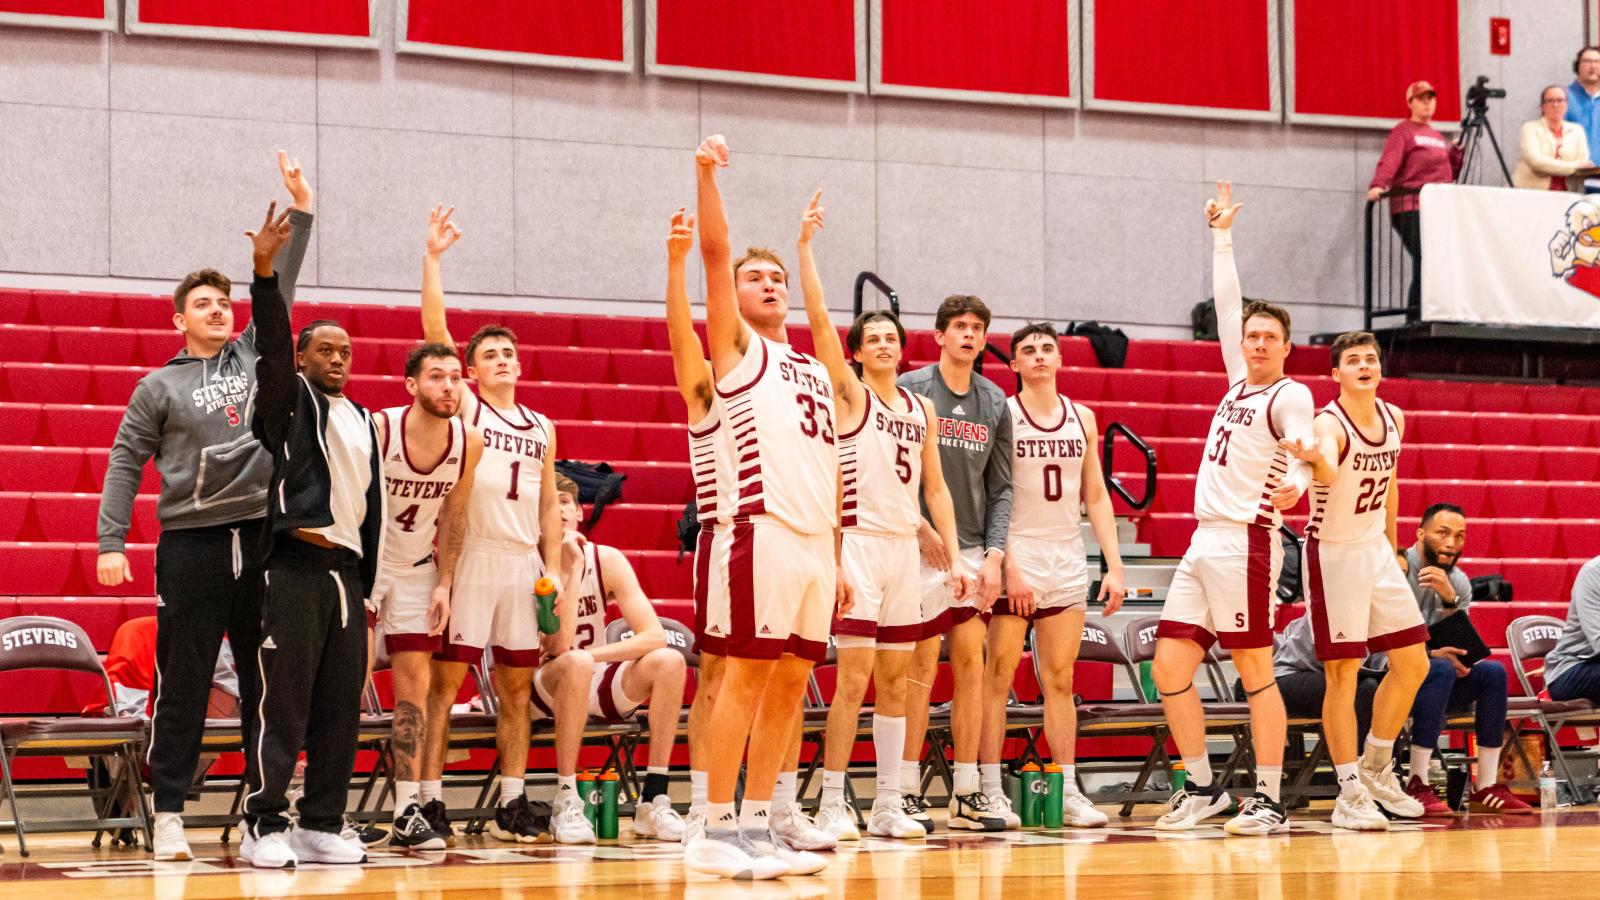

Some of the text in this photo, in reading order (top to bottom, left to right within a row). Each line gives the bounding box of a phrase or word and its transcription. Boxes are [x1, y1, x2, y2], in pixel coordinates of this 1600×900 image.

[192, 371, 248, 407] STEVENS
[779, 362, 833, 400] STVEN
[224, 404, 241, 427] S
[796, 393, 835, 446] 33
[936, 416, 988, 443] TEVENS
[483, 427, 547, 463] STEVENS
[936, 437, 984, 452] SKETBALL
[1016, 439, 1083, 458] STEVENS
[1208, 425, 1232, 467] 31
[895, 443, 912, 485] 5
[385, 476, 453, 499] STEVENS
[506, 460, 520, 502] 1
[1043, 464, 1062, 502] 0
[1354, 476, 1390, 515] 22
[395, 504, 420, 533] 4
[1235, 612, 1245, 628] S
[1522, 625, 1563, 644] STEVEN
[2, 627, 78, 651] STEVENS
